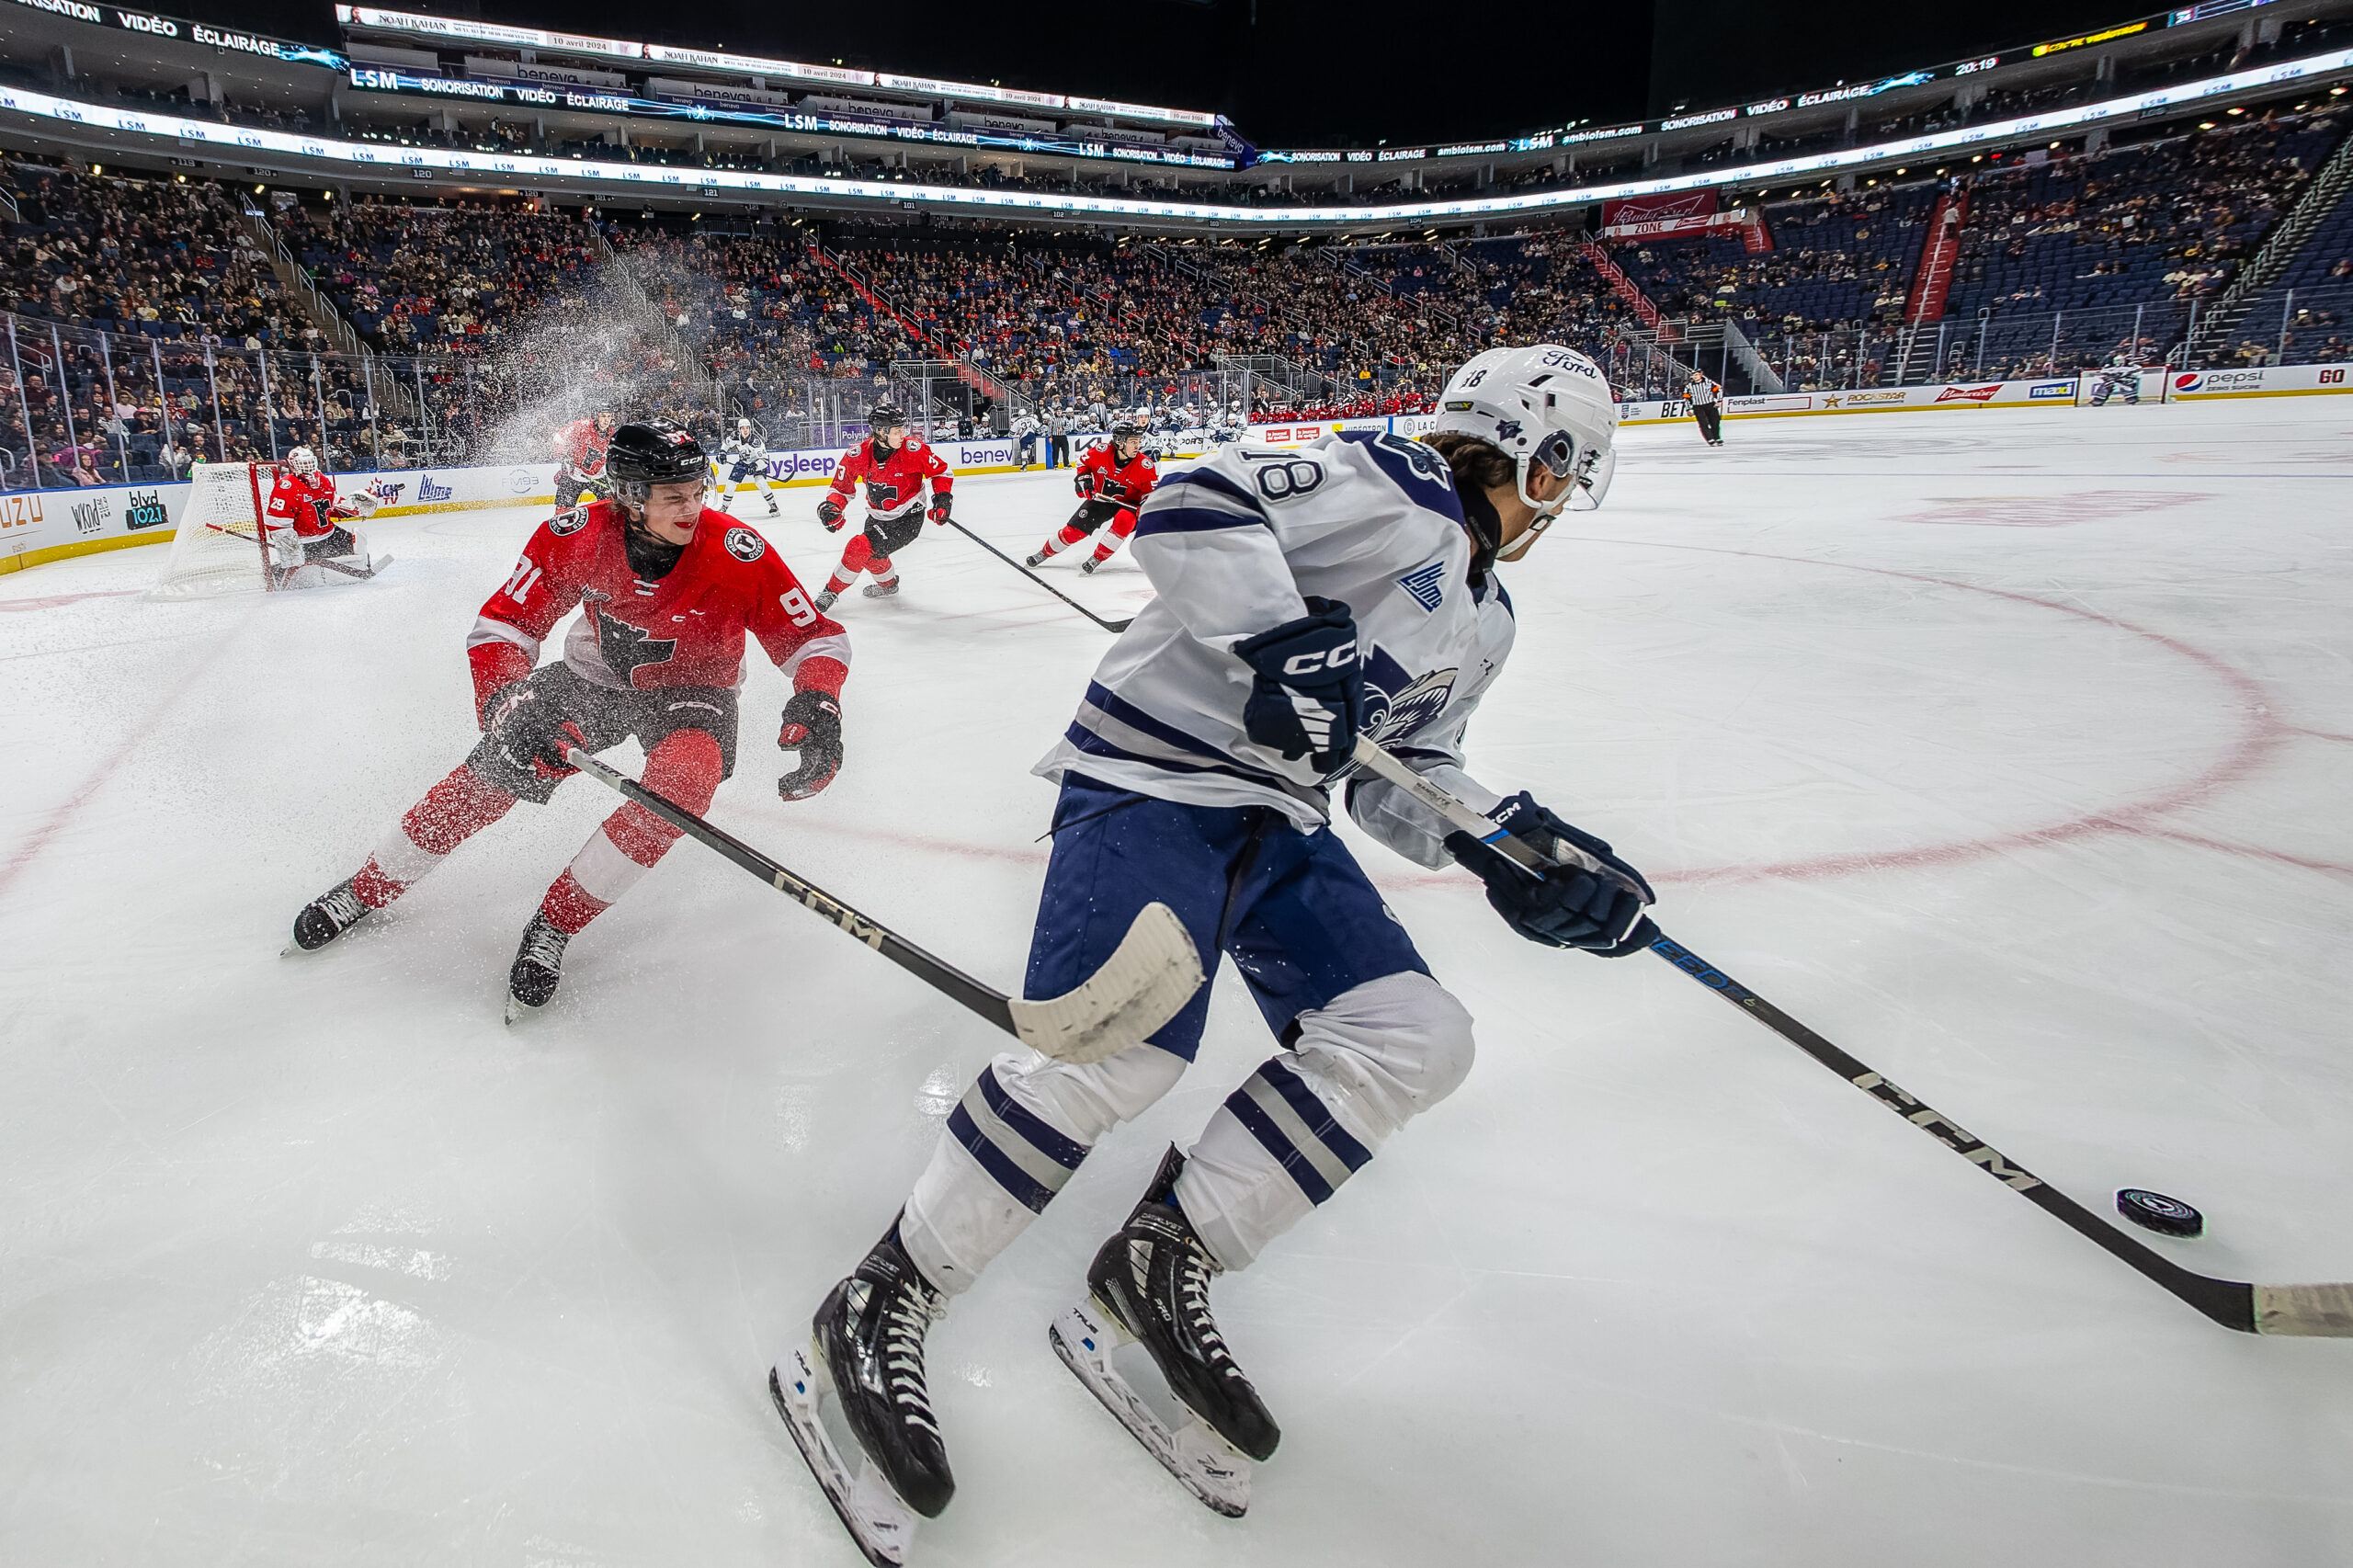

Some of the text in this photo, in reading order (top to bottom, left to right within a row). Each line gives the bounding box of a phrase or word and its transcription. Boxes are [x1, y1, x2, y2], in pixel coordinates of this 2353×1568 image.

[17, 0, 280, 56] ISATION VIDÉO ÉCLAIRAGE
[379, 15, 409, 27] NOAH
[410, 17, 447, 31] KAHAN
[565, 39, 585, 48] avril
[585, 41, 607, 50] 2024
[665, 51, 688, 61] NOAH
[688, 54, 718, 64] KAHAN
[813, 69, 828, 77] avril
[829, 71, 846, 80] 2024
[350, 68, 630, 110] LSM SONORISATION VIDÉO ÉCLAIRAGE
[892, 78, 912, 87] NOAH
[913, 81, 936, 90] KAHAN
[54, 108, 82, 120] LSM
[1661, 85, 1870, 131] SONORISATION VIDÉO ÉCLAIRAGE
[119, 119, 145, 131] LSM
[785, 114, 818, 131] LSM
[829, 120, 887, 136] SONORISATION
[896, 126, 925, 139] VIDÉO
[932, 129, 977, 144] ÉCLAIRAGE
[180, 130, 205, 140] LSM
[238, 138, 261, 147] LSM
[1218, 125, 1245, 153] beneva
[302, 146, 324, 155] LSM
[1519, 135, 1553, 152] LSM
[401, 156, 423, 165] LSM
[1079, 142, 1104, 157] LSM
[1113, 148, 1157, 161] SONORISATION
[1164, 152, 1186, 164] VIDÉO
[1347, 150, 1372, 162] VIDÉO
[1379, 148, 1426, 162] ÉCLAIRAGE
[414, 169, 432, 178] 120
[494, 164, 515, 172] LSM
[704, 188, 719, 197] 121
[1635, 222, 1662, 233] ZONE
[1543, 350, 1597, 379] Ford
[2207, 370, 2265, 385] pepsi
[2032, 383, 2073, 396] maxi
[1728, 398, 1766, 406] Fenplast
[1847, 392, 1906, 403] ROCKSTAR
[1418, 422, 1427, 431] LA
[842, 430, 870, 441] Polysle
[680, 455, 703, 466] CCM
[961, 446, 1013, 464] benev
[767, 453, 835, 478] lysleep
[1241, 451, 1324, 501] 18
[130, 490, 158, 507] blvd
[270, 496, 286, 511] 29
[505, 554, 543, 605] 91
[779, 587, 816, 628] 9
[1282, 640, 1357, 676] CC
[775, 871, 884, 950] CCM
[1652, 939, 1728, 989] EED
[1852, 1072, 2043, 1193] CCM
[1154, 1298, 1172, 1322] PRO
[1074, 1307, 1098, 1334] TRUE
